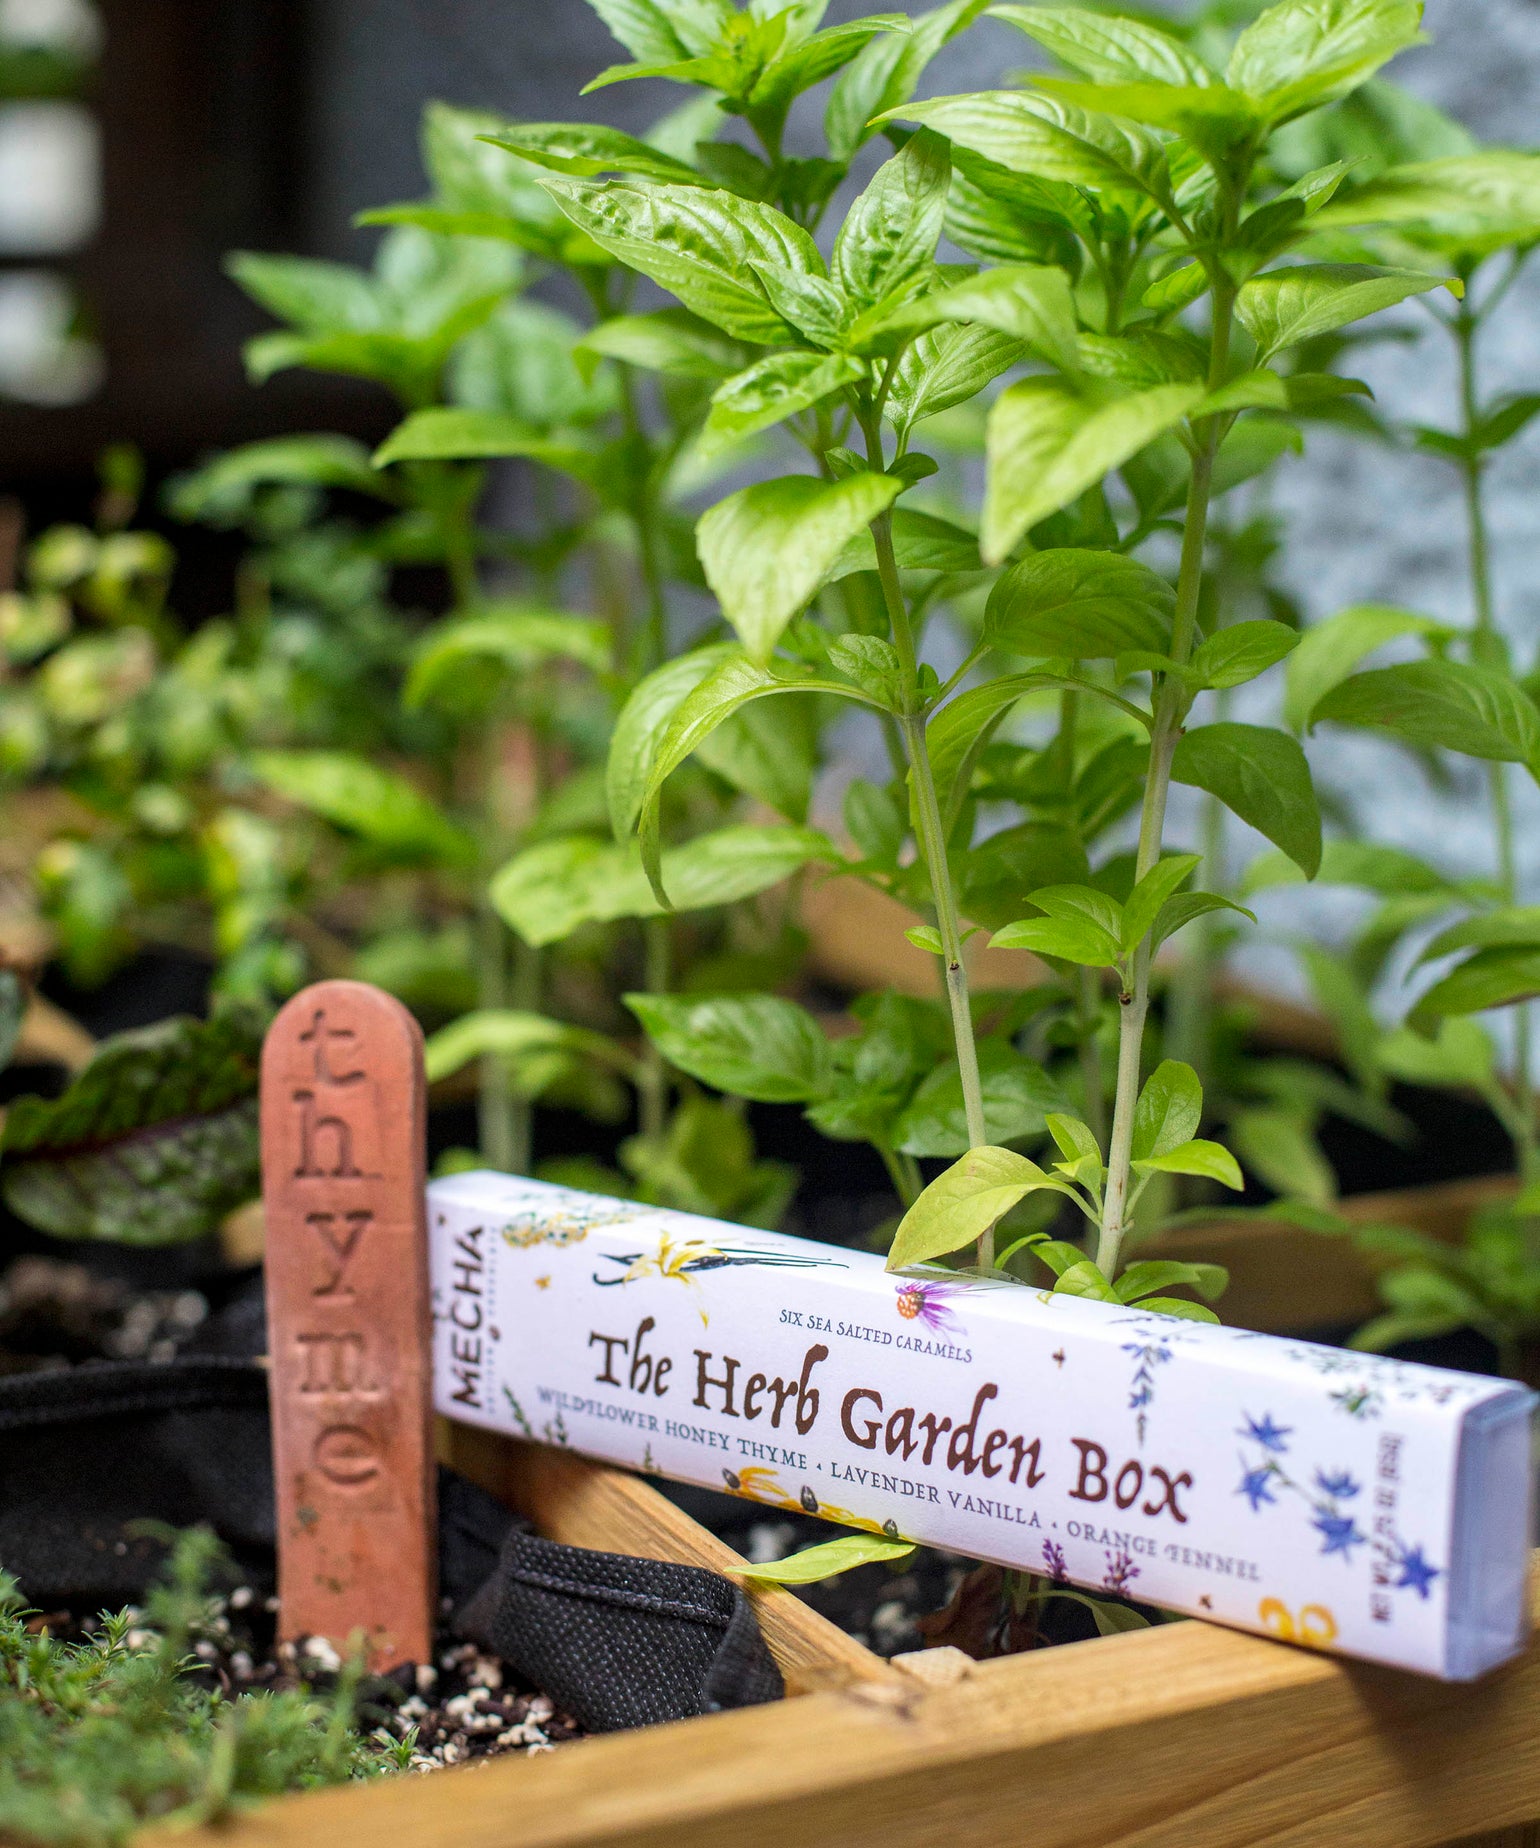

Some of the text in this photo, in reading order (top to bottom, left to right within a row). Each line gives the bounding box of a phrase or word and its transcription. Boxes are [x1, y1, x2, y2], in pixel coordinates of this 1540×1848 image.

[292, 1008, 382, 1486] thyme
[452, 1223, 485, 1408] MECHA
[779, 1308, 973, 1364] SIX SEA SALTED CARAMELS
[537, 1385, 1261, 1582] WILDFLOWER HONEY THYME LAVENDER VANILLA ORANGE FENNEL
[588, 1316, 672, 1396] The
[692, 1343, 829, 1435] Herb
[840, 1382, 1045, 1488] Garden
[1068, 1437, 1193, 1523] Box
